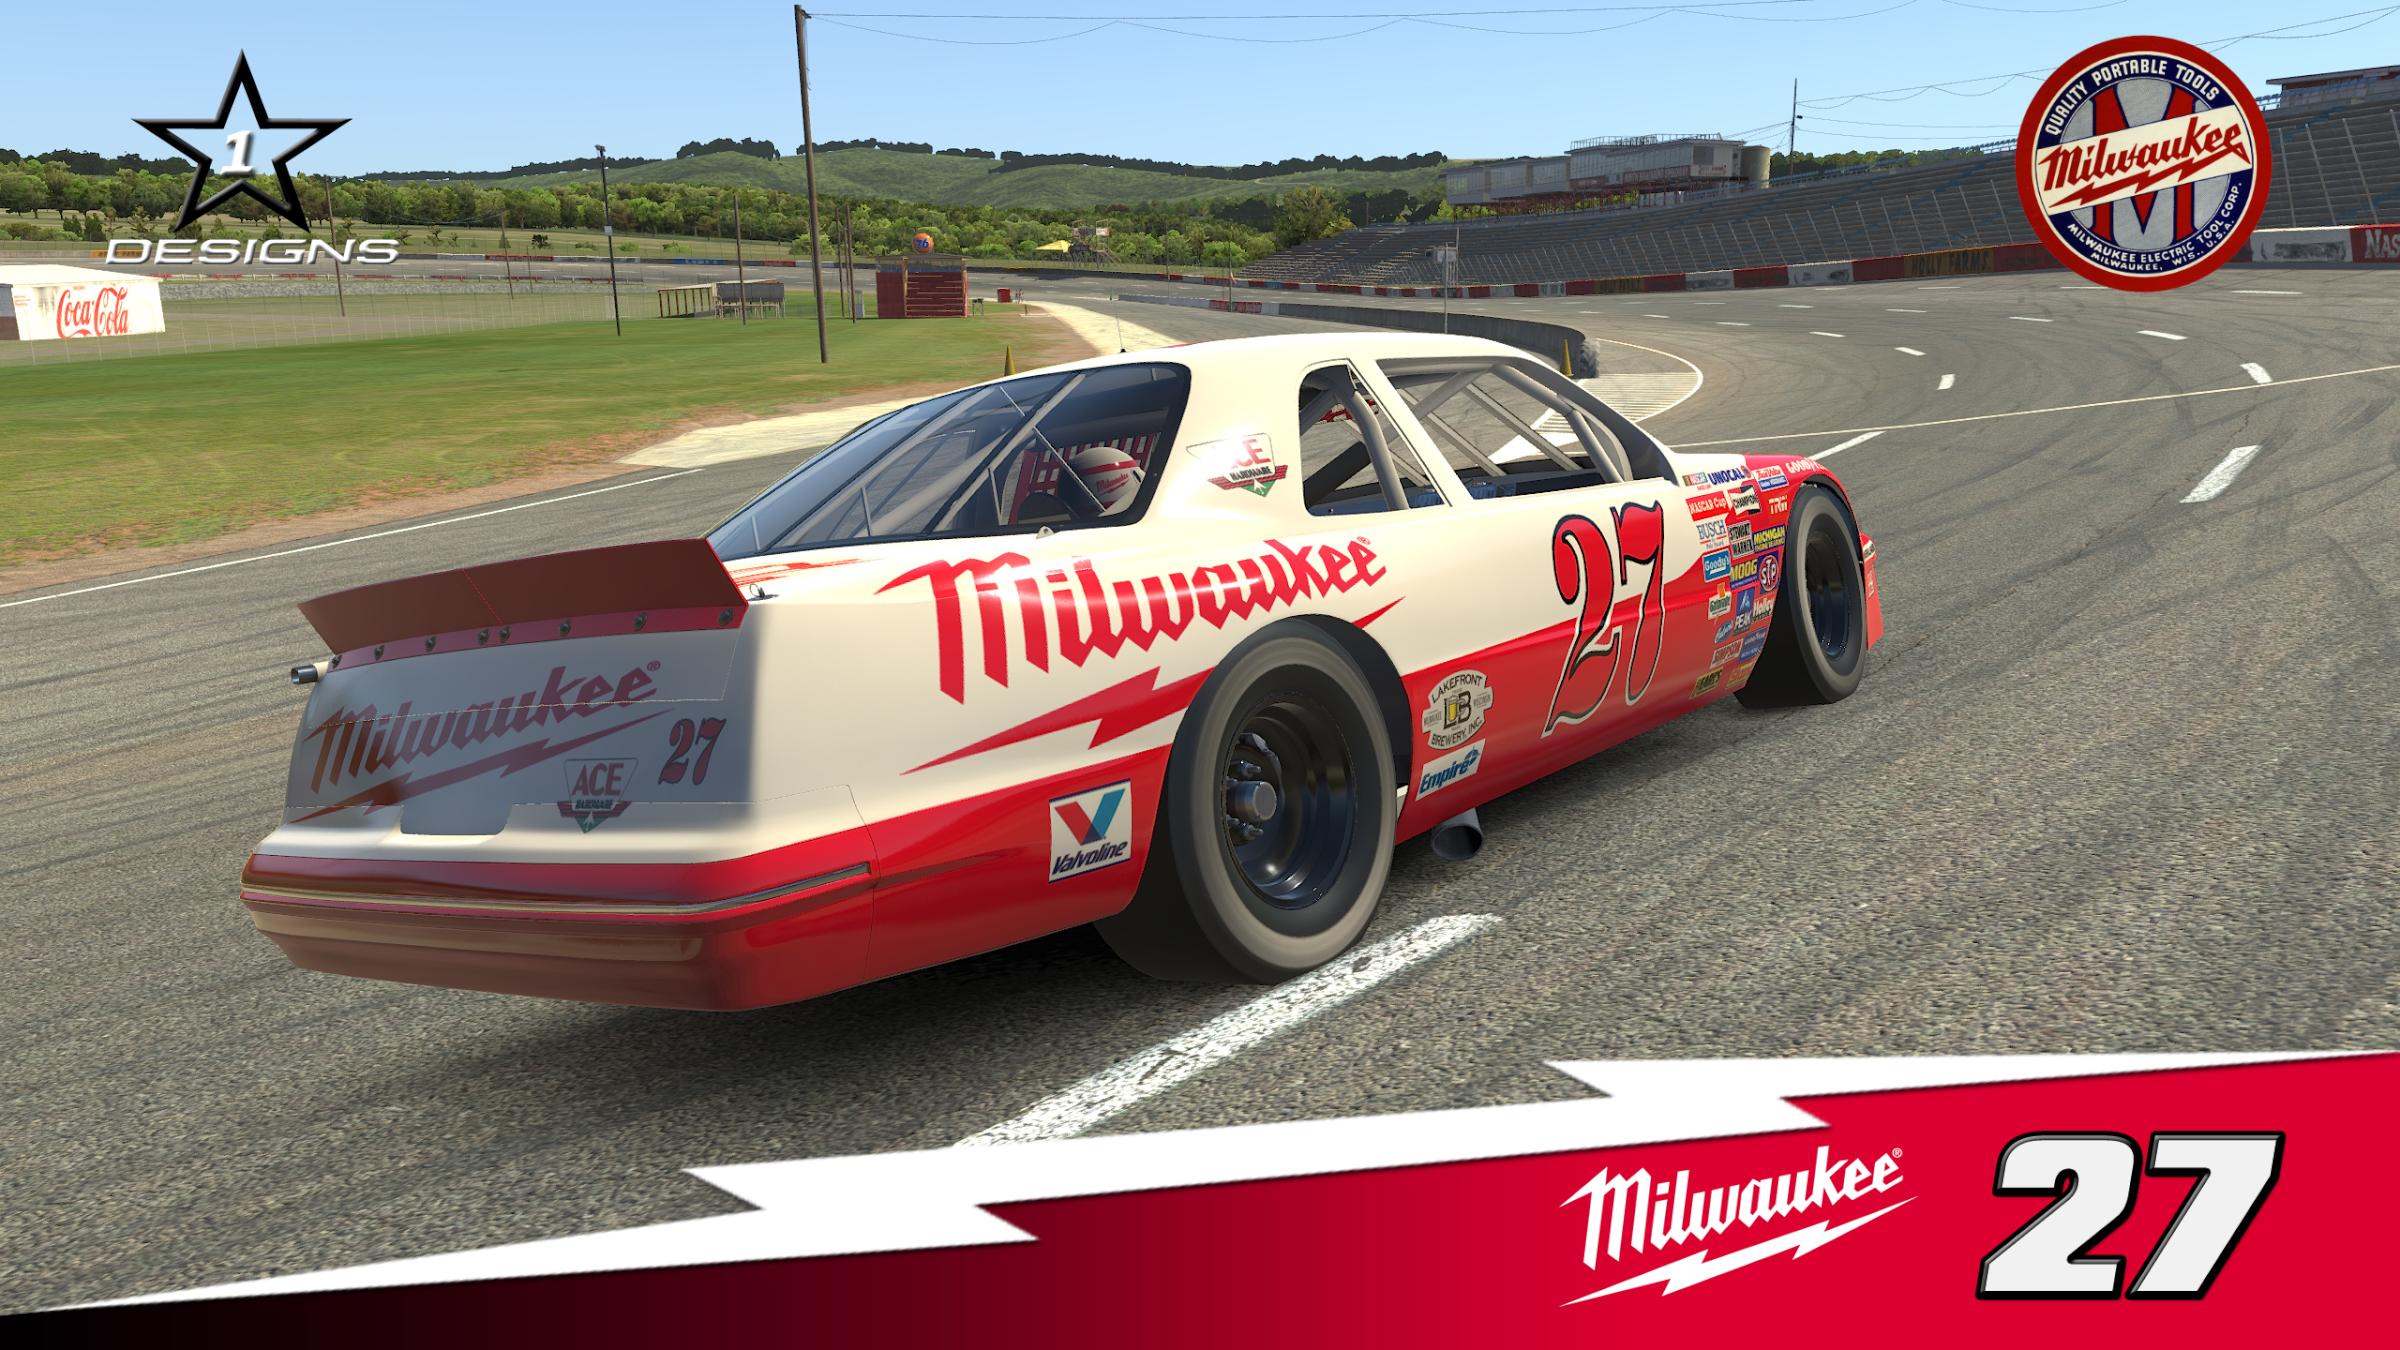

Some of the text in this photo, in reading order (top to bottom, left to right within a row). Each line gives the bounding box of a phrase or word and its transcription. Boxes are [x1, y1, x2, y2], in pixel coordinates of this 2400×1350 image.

[916, 238, 929, 249] 76
[1229, 466, 1272, 481] HARDWARE
[1707, 468, 1746, 485] UNOCAL
[1689, 497, 1727, 514] NASCAR Cup
[1733, 494, 1760, 509] CHAMPION
[1696, 519, 1727, 540] BUSCH
[1753, 526, 1785, 545] MICHIGAN
[1704, 555, 1731, 572] Goody's
[1730, 559, 1758, 582] MOOG
[1761, 559, 1777, 587] STP
[1753, 597, 1775, 618] Holley
[1541, 500, 1665, 738] 27
[1735, 610, 1753, 631] PEAK
[1431, 673, 1483, 704] LAKEFRONT
[658, 717, 728, 787] 27
[572, 763, 625, 797] ACE
[1052, 841, 1128, 875] Valvoline
